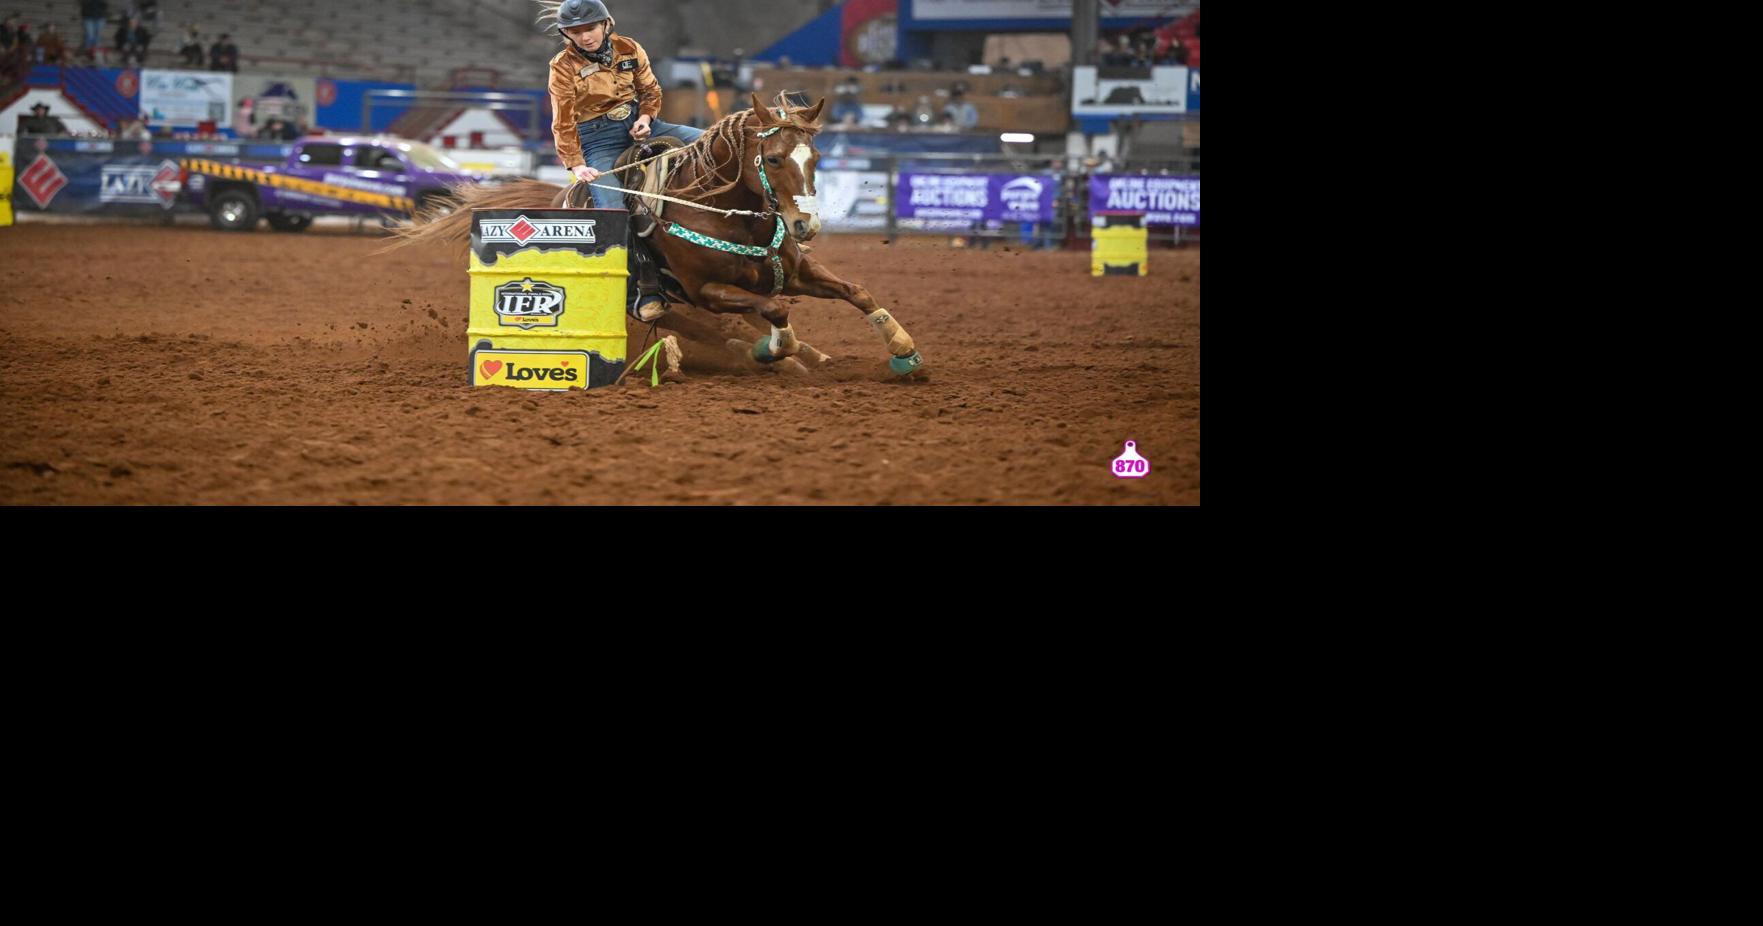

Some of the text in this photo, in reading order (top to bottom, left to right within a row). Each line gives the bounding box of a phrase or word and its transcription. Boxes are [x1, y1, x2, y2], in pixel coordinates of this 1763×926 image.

[1106, 189, 1200, 211] AUCTIONS
[482, 225, 506, 237] AZY
[540, 225, 594, 237] ARENA
